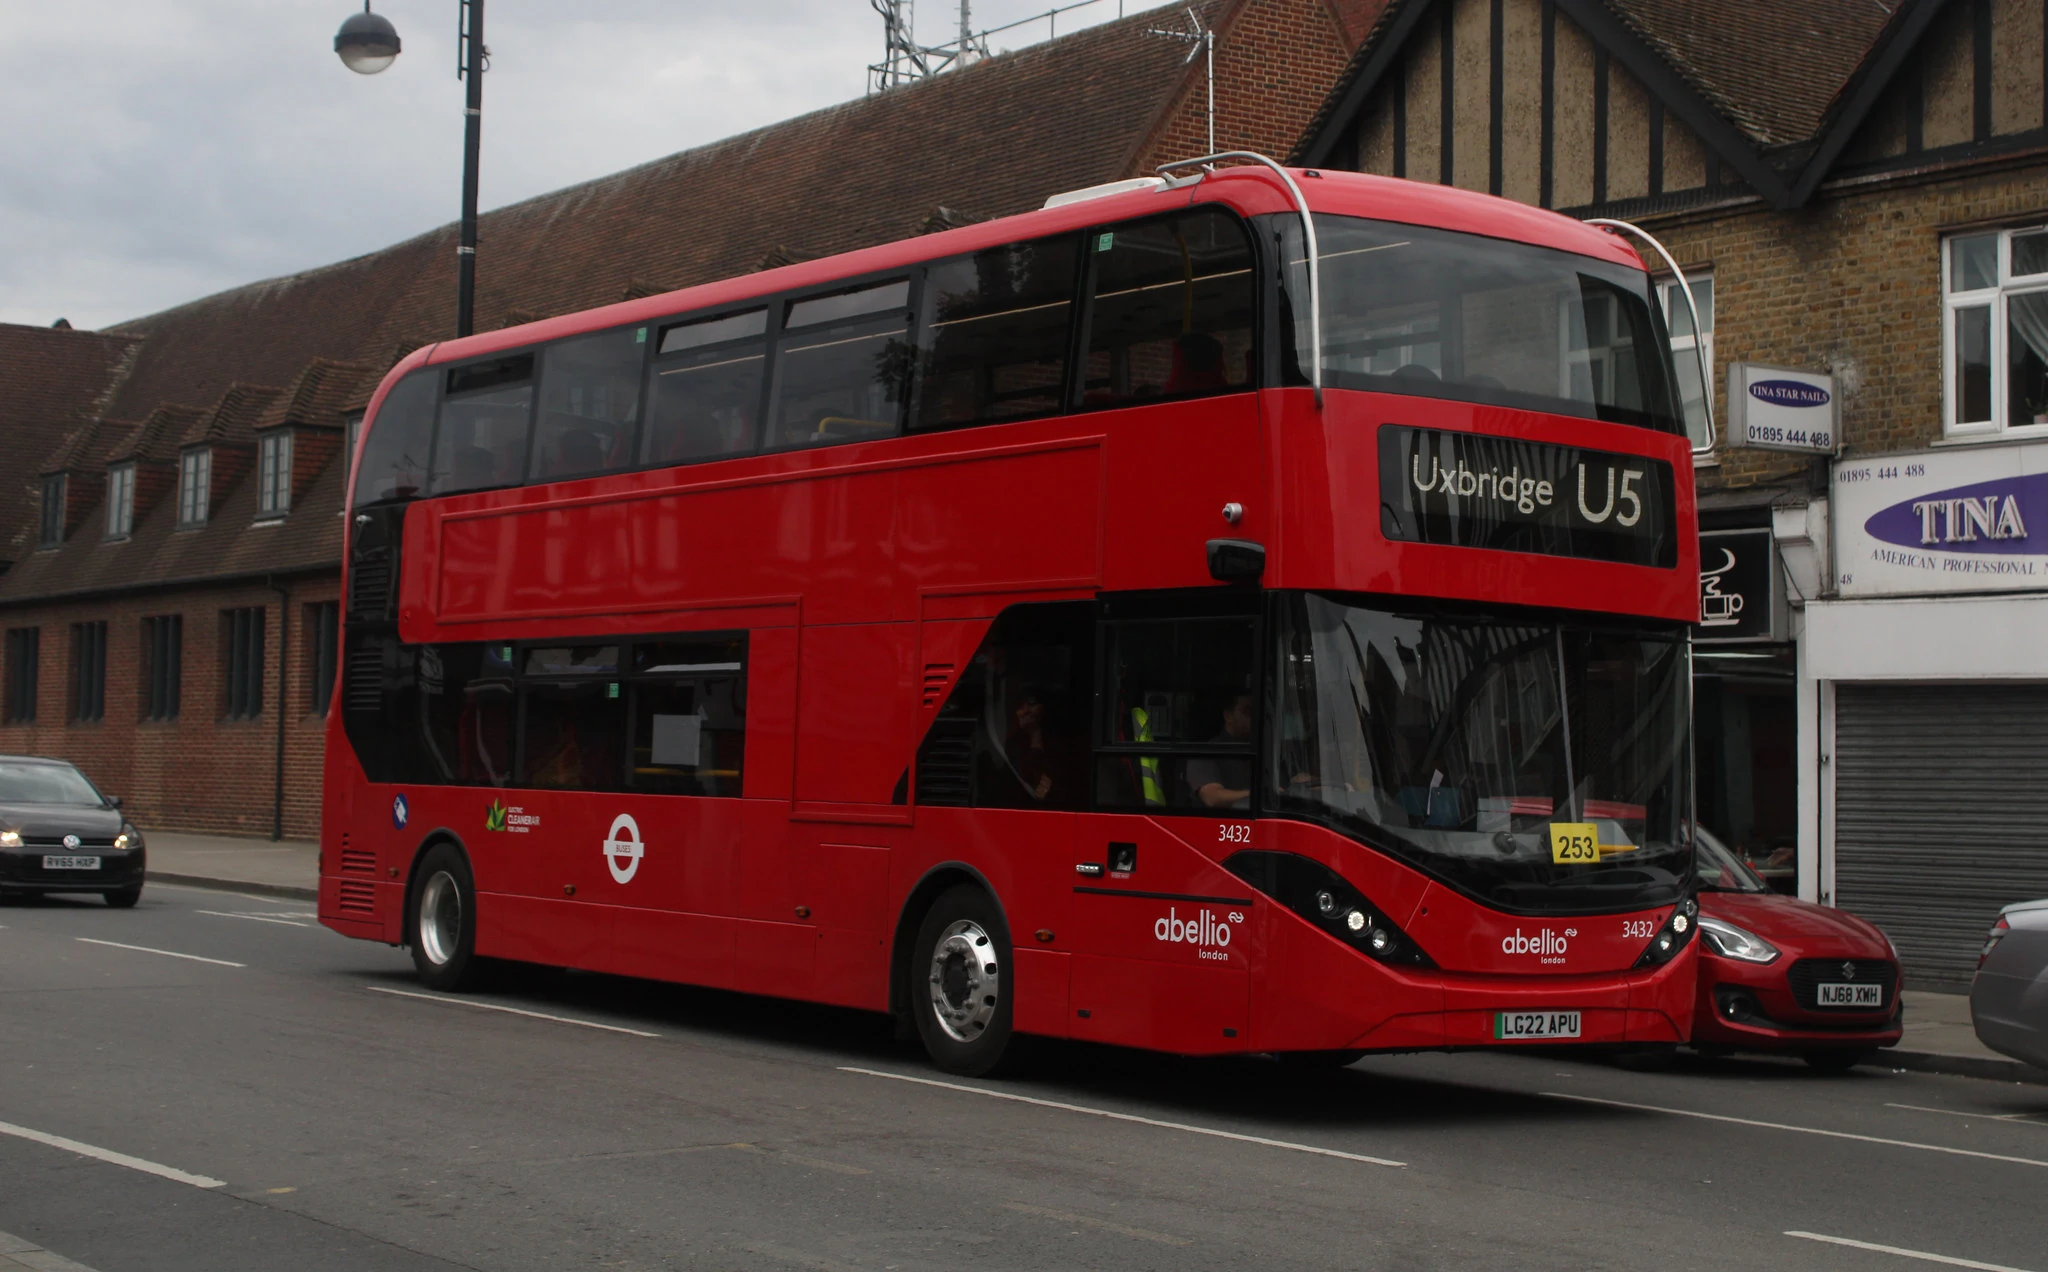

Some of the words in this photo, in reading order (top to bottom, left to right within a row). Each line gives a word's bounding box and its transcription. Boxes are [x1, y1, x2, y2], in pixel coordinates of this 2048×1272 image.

[1753, 385, 1774, 397] TINA
[1776, 387, 1798, 399] STAR
[1800, 389, 1828, 402] NAILS
[1749, 425, 1783, 442] 01895
[1786, 429, 1806, 443] 444
[1810, 432, 1830, 446] 488
[1840, 468, 1871, 483] 01895
[1878, 466, 1898, 479] 444
[1905, 464, 1925, 477] 488
[1413, 454, 1553, 514] Uxbridge
[1578, 463, 1644, 527] U5
[1913, 494, 2028, 544] TINA
[1871, 548, 1936, 570] AMERICAN
[1943, 558, 2037, 575] PROFESSIONAL
[1840, 573, 1852, 585] 48
[1218, 824, 1251, 843] 3432
[1559, 836, 1594, 859] 253
[1155, 907, 1231, 947] abellio
[1622, 921, 1653, 938] 3432
[1502, 928, 1567, 955] abellio
[1199, 948, 1228, 961] london
[1541, 956, 1565, 964] london
[1823, 986, 1852, 1003] NJ68
[1856, 986, 1877, 1003] XWH
[1505, 1015, 1544, 1034] LG22
[1548, 1014, 1578, 1033] APU
